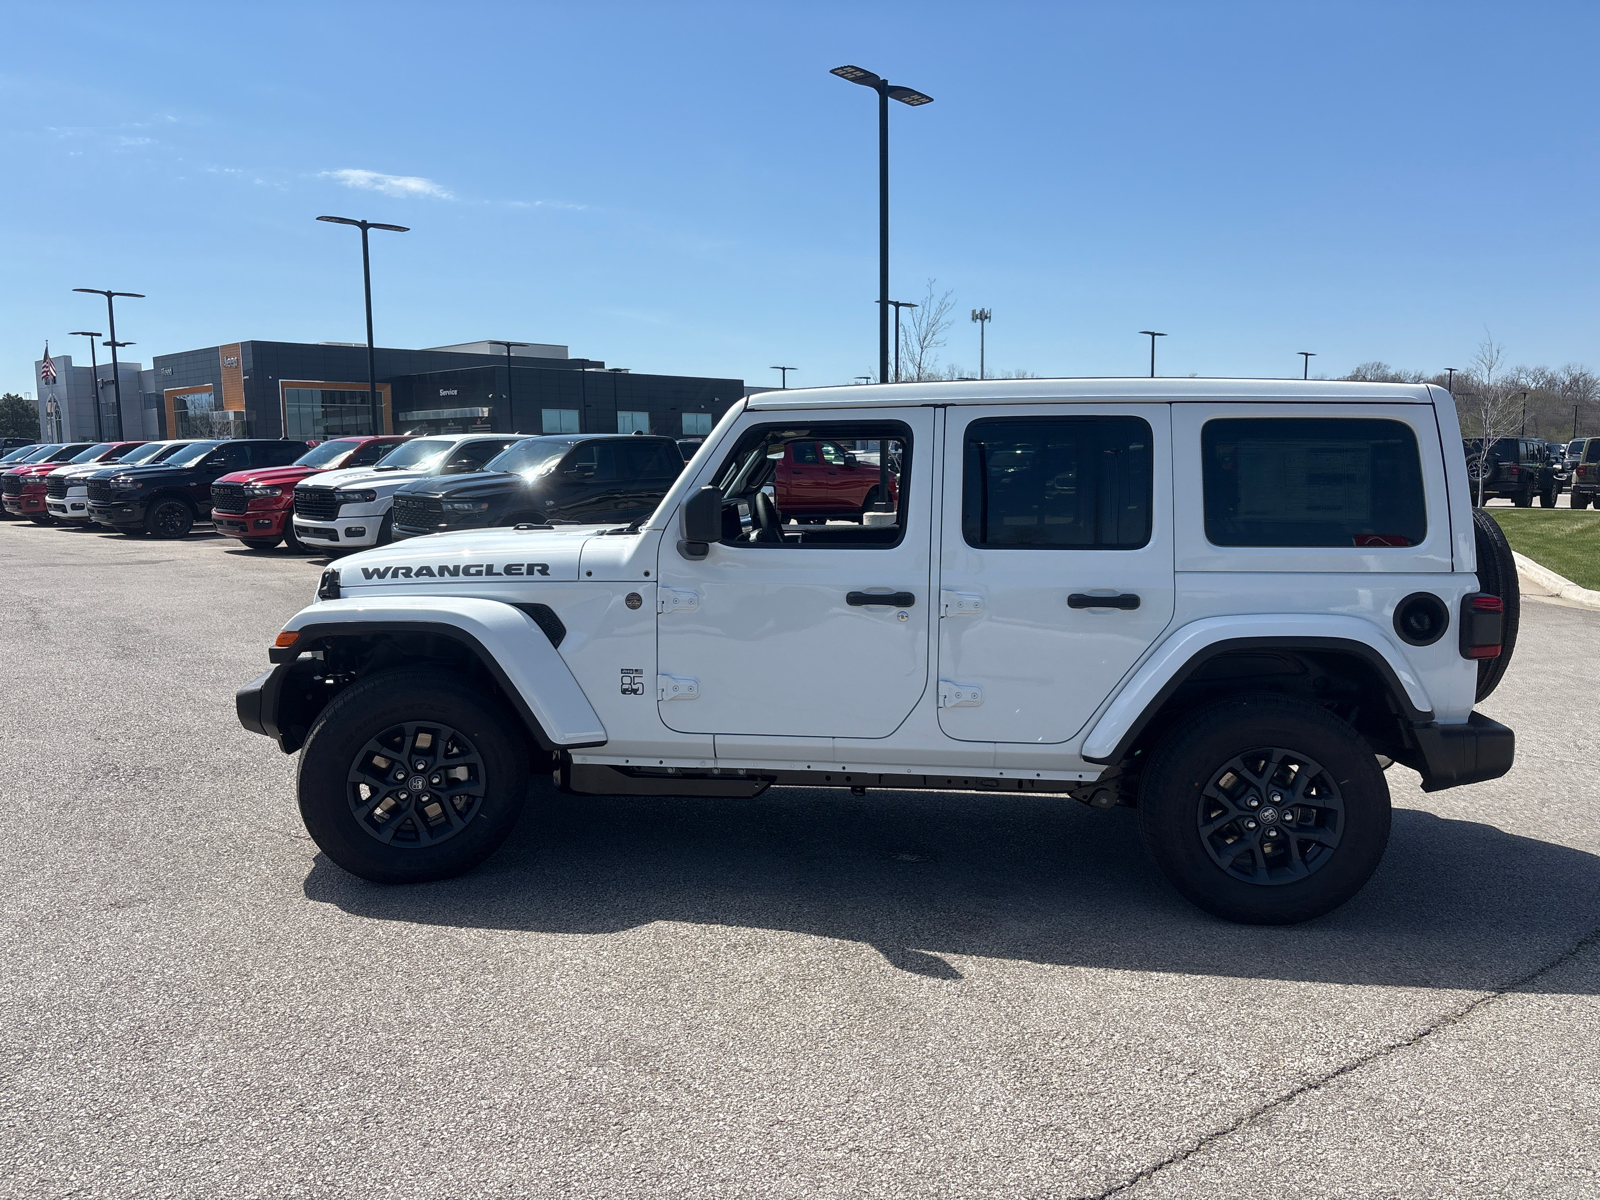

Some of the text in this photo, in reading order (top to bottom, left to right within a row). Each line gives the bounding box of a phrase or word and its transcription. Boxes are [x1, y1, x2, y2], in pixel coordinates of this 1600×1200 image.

[223, 356, 238, 367] Jeep
[439, 388, 458, 396] Service
[299, 493, 319, 501] RAM
[361, 563, 551, 580] WRANGLER
[621, 675, 645, 695] 85
